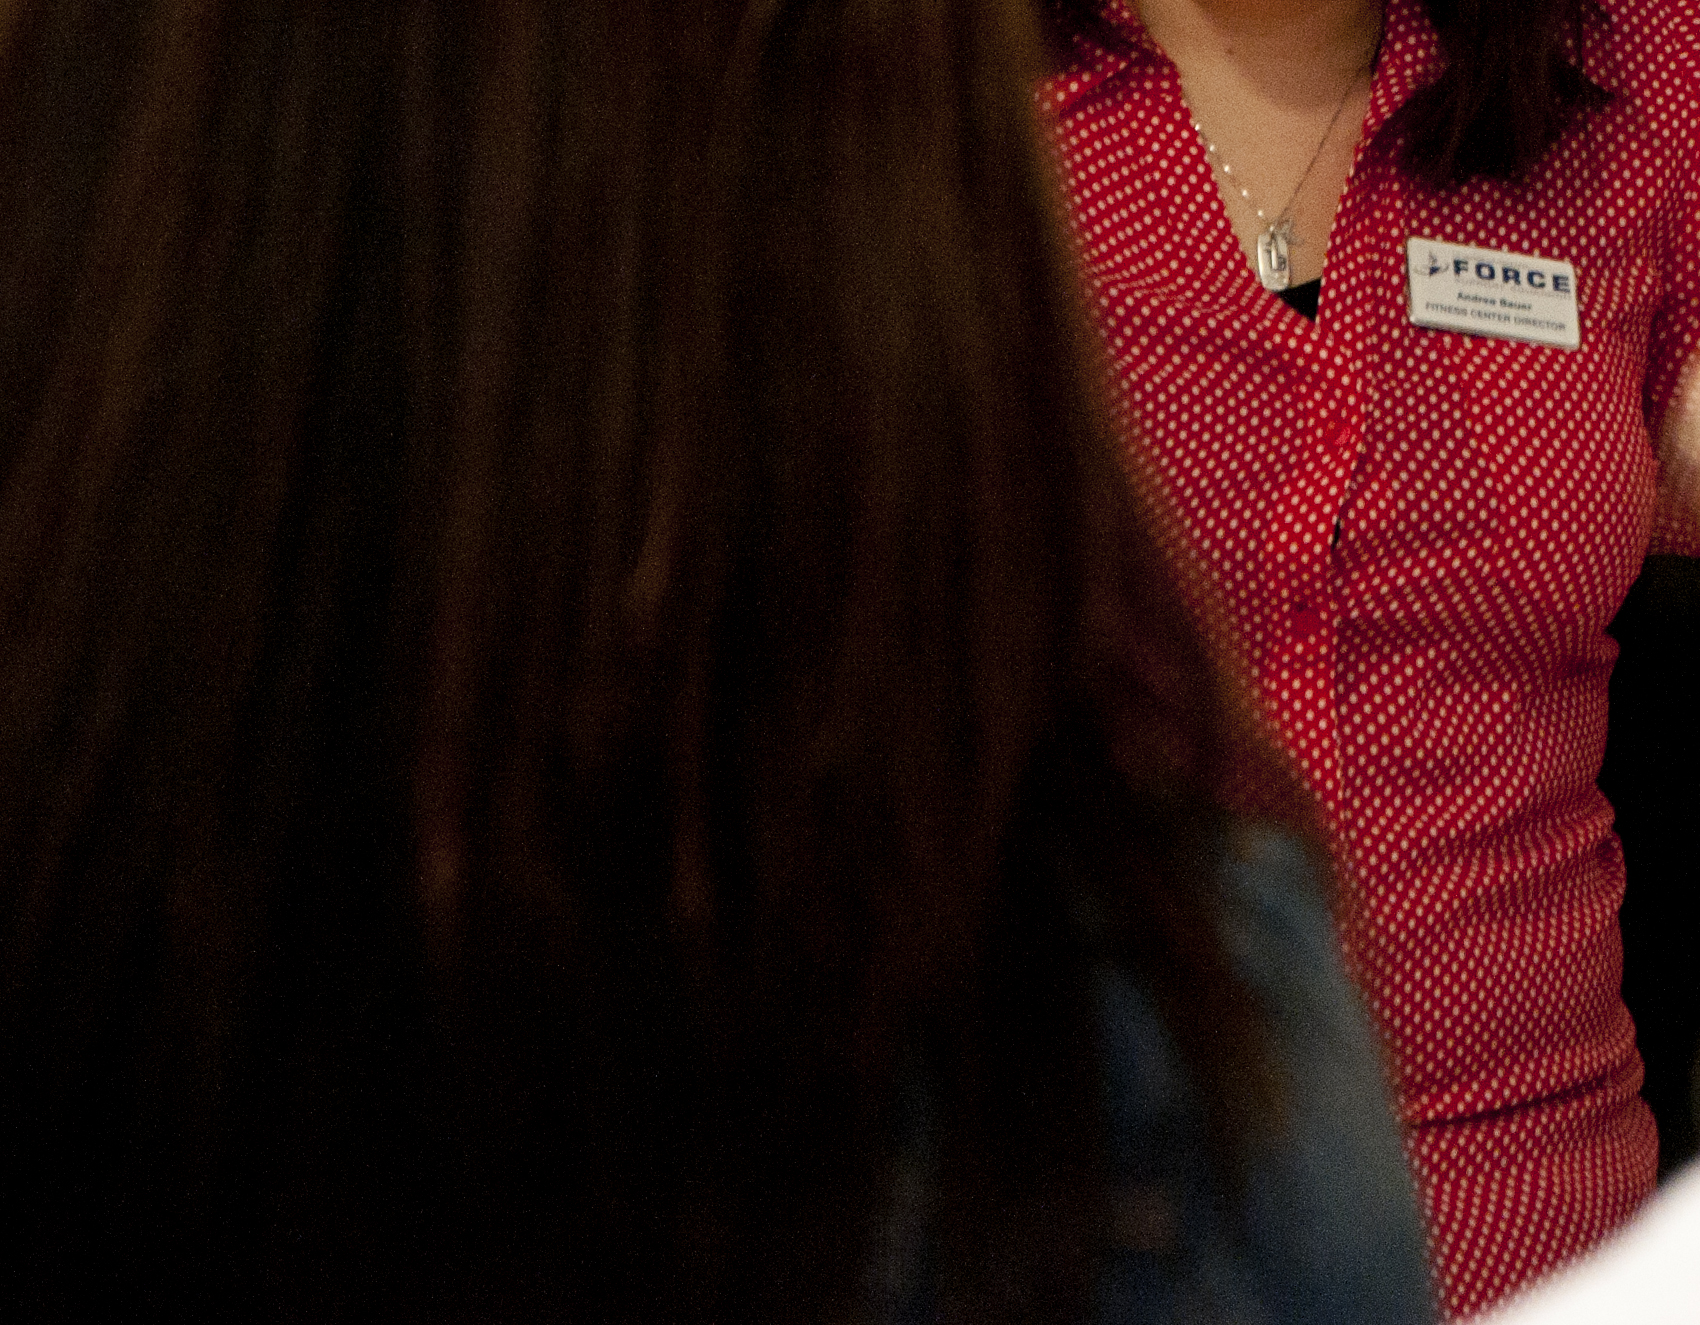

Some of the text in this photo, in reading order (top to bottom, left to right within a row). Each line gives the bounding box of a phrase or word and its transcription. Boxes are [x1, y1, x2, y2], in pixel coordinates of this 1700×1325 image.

[1453, 258, 1571, 293] FORCE
[1457, 292, 1497, 307] Andrea
[1425, 301, 1566, 331] FITNESS CENTER DIRECTOR
